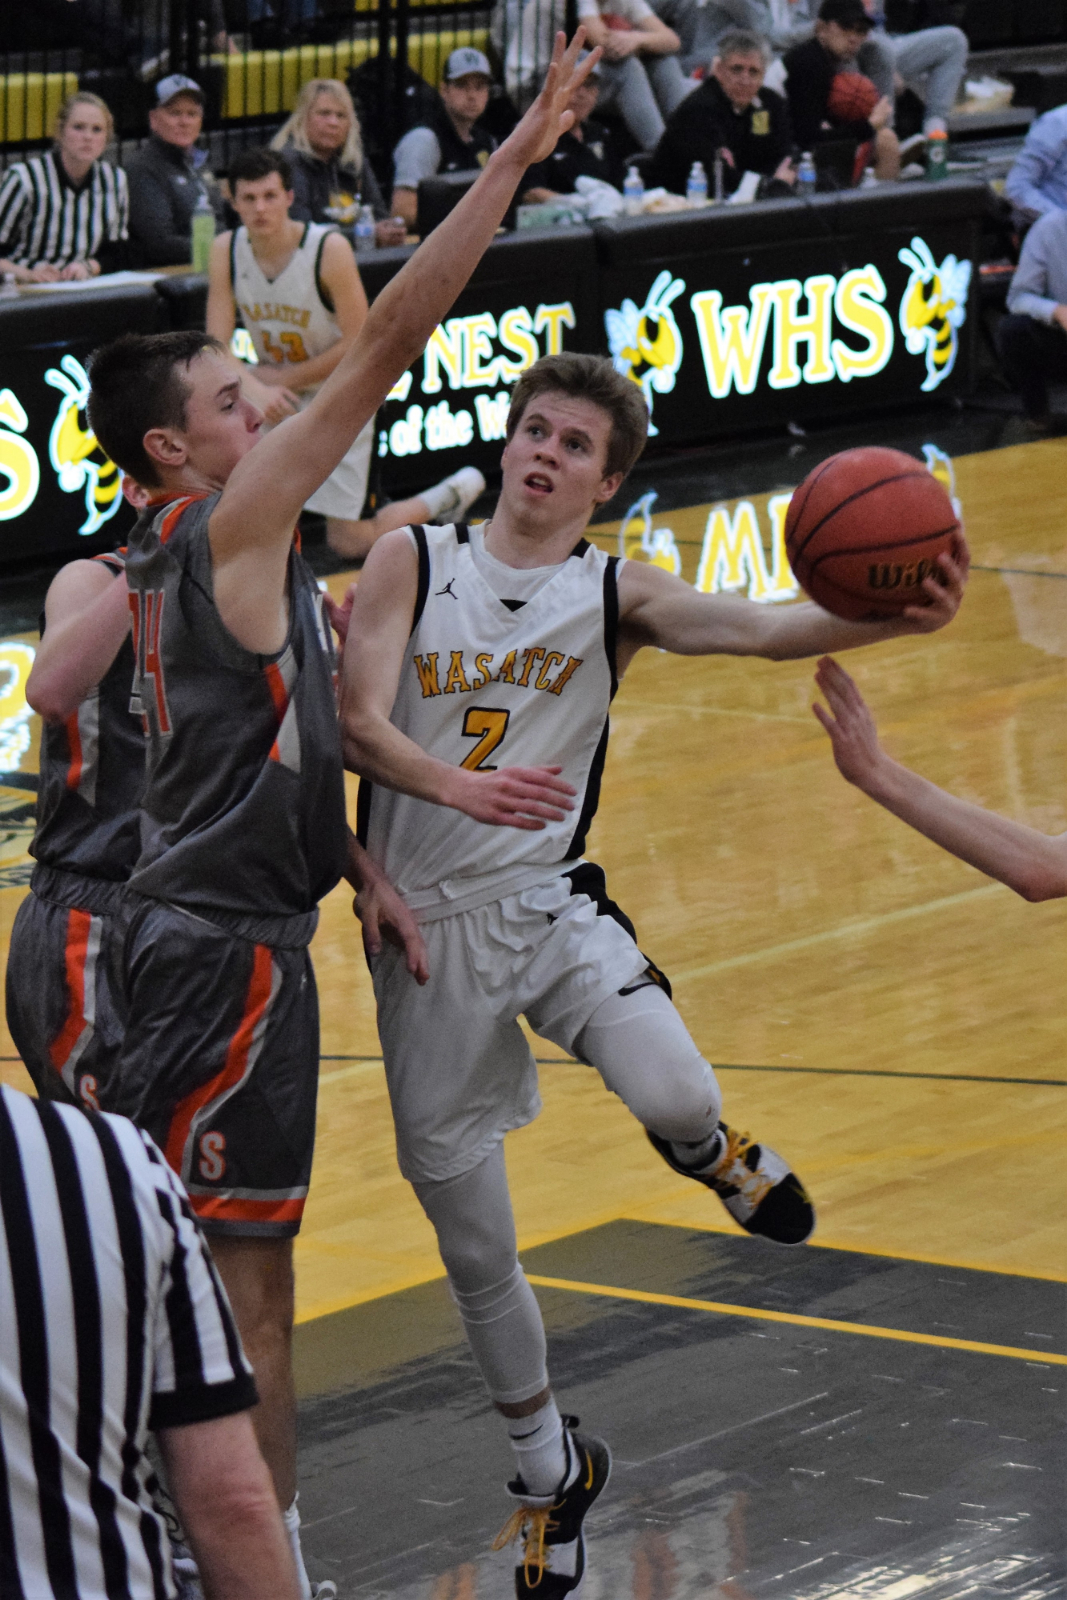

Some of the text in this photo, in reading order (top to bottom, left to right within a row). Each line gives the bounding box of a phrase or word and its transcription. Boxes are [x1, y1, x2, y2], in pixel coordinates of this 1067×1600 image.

[421, 301, 577, 394] NEST
[690, 263, 895, 399] WHS
[389, 404, 424, 457] of
[424, 400, 474, 451] the
[413, 647, 584, 699] WASATCH
[459, 706, 511, 773] 2
[200, 1131, 226, 1181] S
